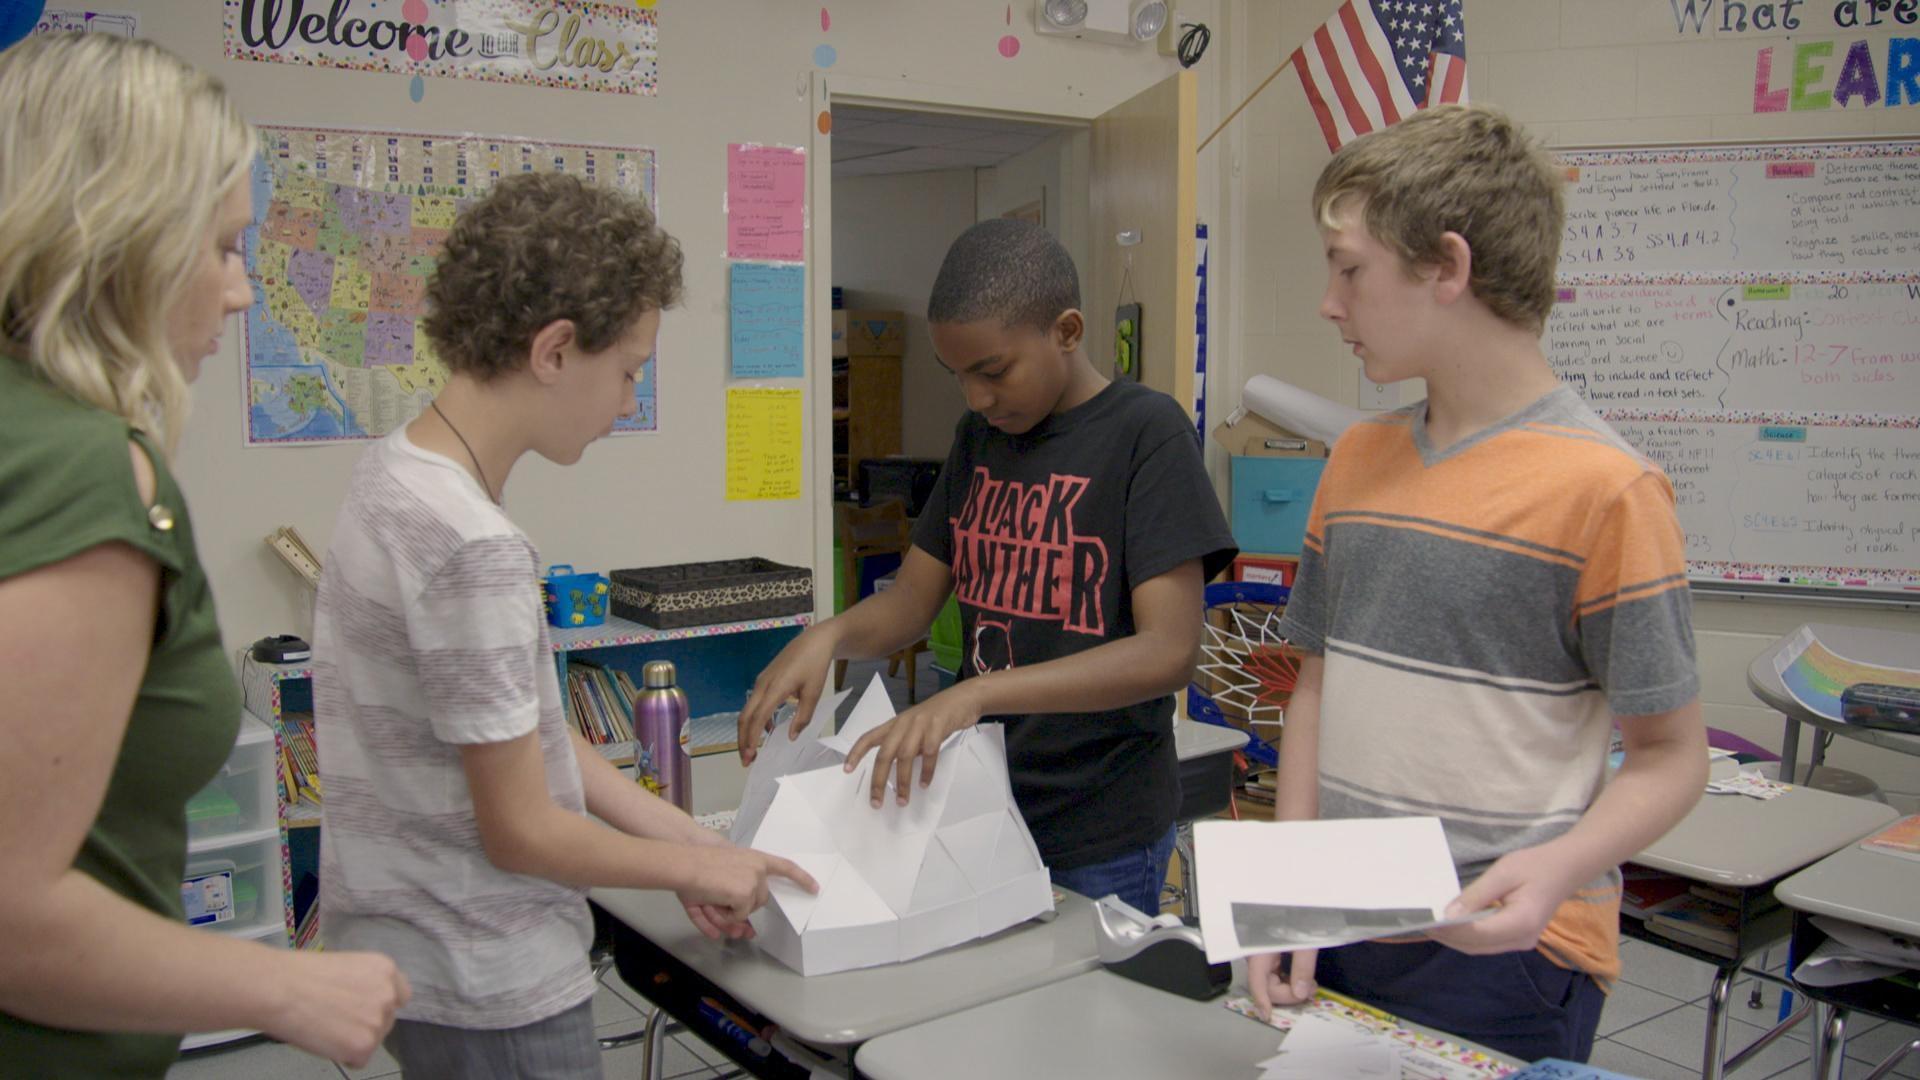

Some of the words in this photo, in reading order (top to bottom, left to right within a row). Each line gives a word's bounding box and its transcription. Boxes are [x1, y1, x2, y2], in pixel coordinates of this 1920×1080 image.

[1670, 0, 1803, 35] What
[1833, 0, 1920, 28] are
[239, 0, 474, 61] Welcome
[505, 8, 640, 73] Class
[1630, 168, 1648, 179] how
[1577, 185, 1593, 194] and
[1791, 192, 1841, 207] Compare
[1846, 188, 1865, 199] and
[1567, 209, 1597, 219] scribe
[1605, 209, 1638, 221] pioneer
[1644, 205, 1661, 216] life
[1810, 206, 1838, 214] view
[1845, 203, 1854, 211] in
[1862, 198, 1898, 209] which
[1792, 250, 1813, 261] how
[1820, 249, 1844, 264] they
[1851, 246, 1889, 256] relate
[1895, 245, 1906, 254] to
[1569, 306, 1589, 317] will
[1593, 303, 1621, 316] write
[1629, 303, 1641, 314] to
[1551, 320, 1584, 333] reflect
[1590, 319, 1616, 331] what
[1624, 317, 1640, 328] we
[1646, 318, 1664, 327] are
[1735, 308, 1811, 342] Reading:
[1551, 338, 1590, 358] learning
[1596, 337, 1607, 346] in
[1731, 345, 1788, 369] Math:
[1591, 351, 1610, 364] and
[1553, 368, 1586, 389] riting
[1594, 370, 1606, 383] to
[1609, 368, 1646, 382] include
[1650, 367, 1670, 381] and
[1674, 368, 1715, 382] reflect
[1801, 368, 1841, 384] both
[1851, 368, 1896, 384] sides
[1590, 388, 1615, 401] have
[1617, 388, 1640, 400] read
[1643, 390, 1654, 398] in
[1657, 387, 1678, 398] text
[1658, 426, 1700, 437] fraction
[1806, 446, 1862, 469] Identify
[1868, 447, 1887, 460] the
[957, 466, 1090, 548] BLACK
[1832, 490, 1857, 512] they
[1860, 493, 1879, 502] are
[953, 532, 1109, 637] ANTHER
